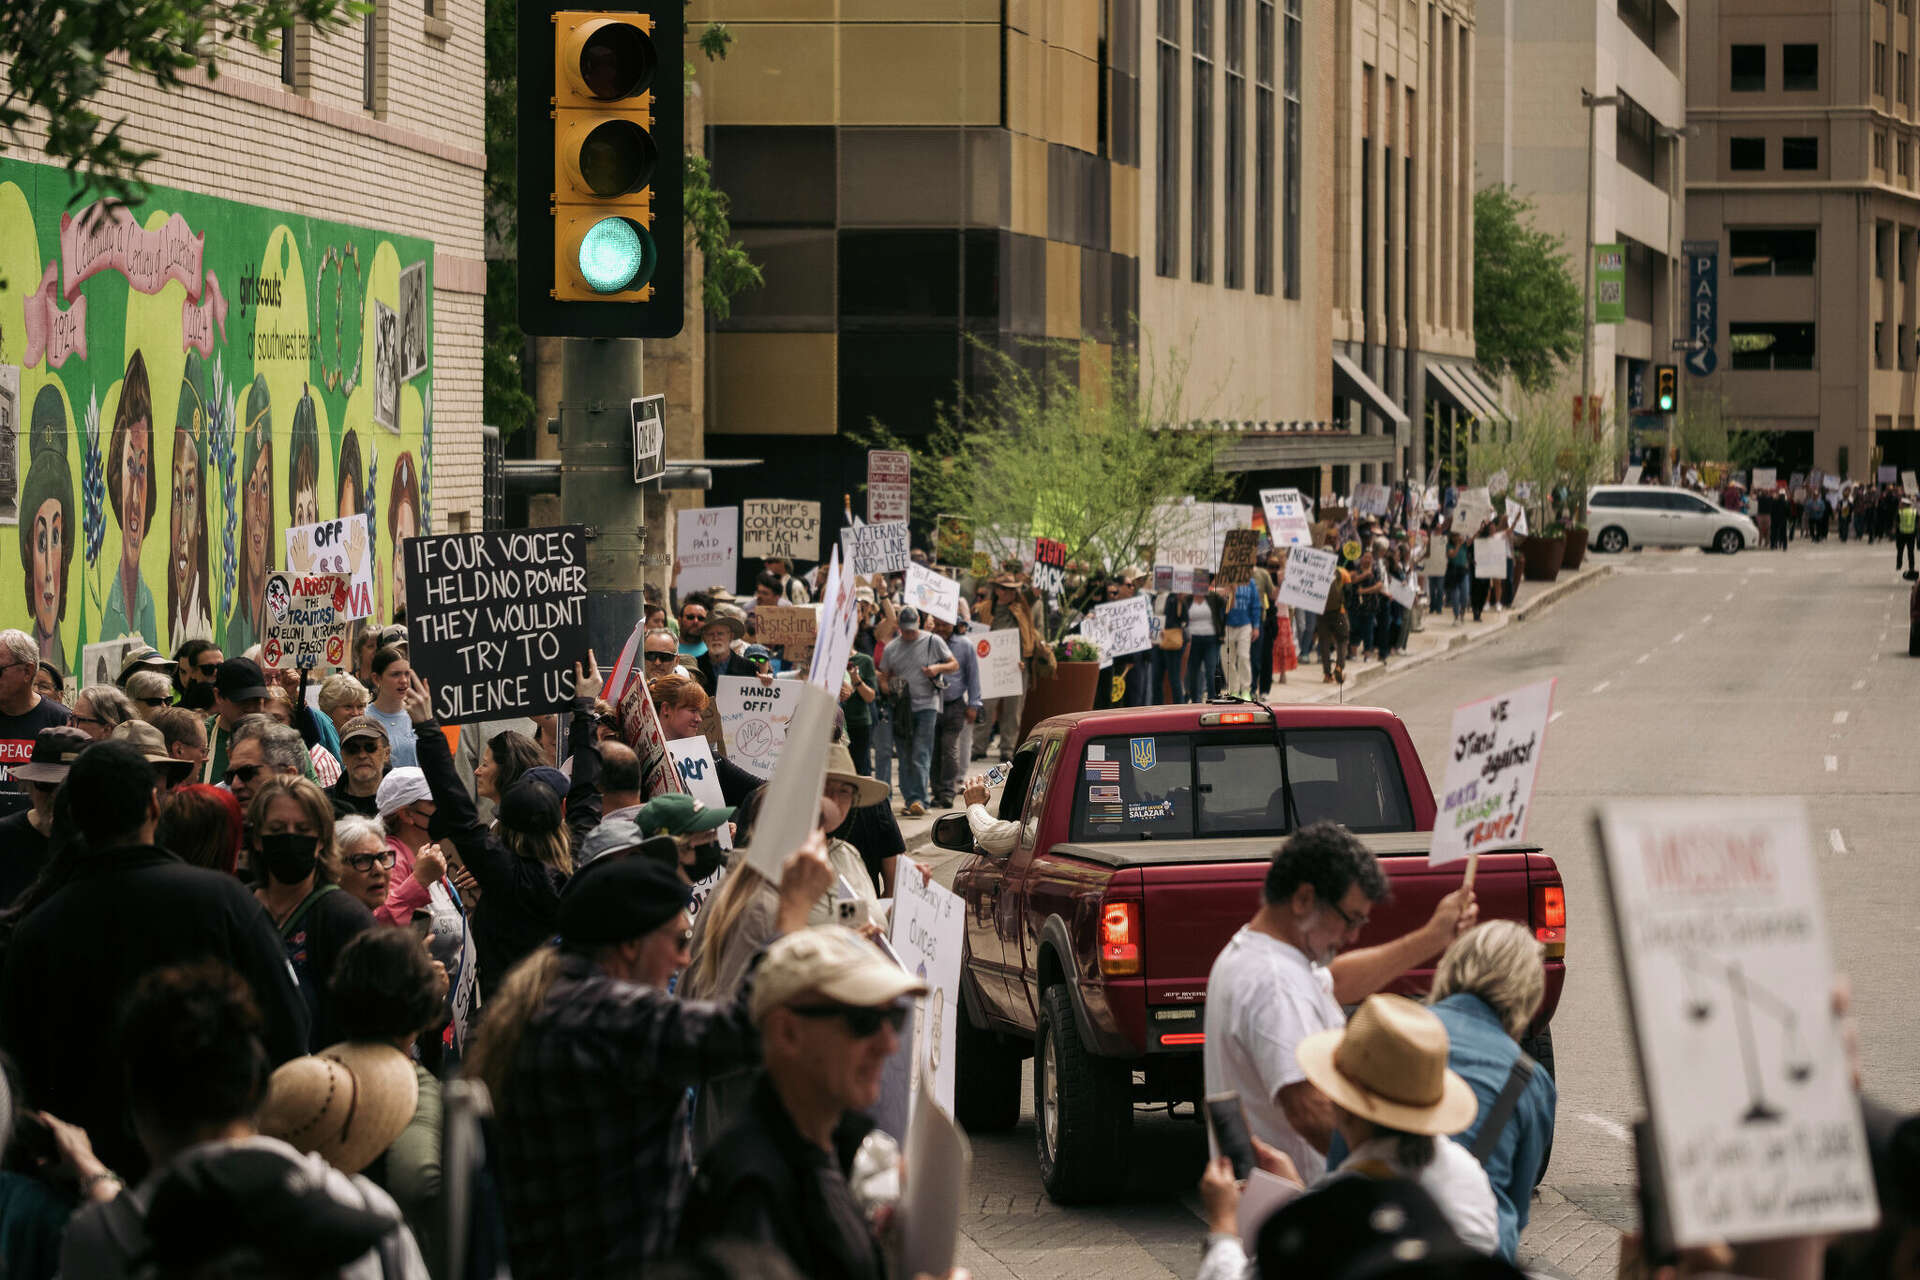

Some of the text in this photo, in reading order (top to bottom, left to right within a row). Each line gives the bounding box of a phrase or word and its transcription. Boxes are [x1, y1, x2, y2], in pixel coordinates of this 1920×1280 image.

[240, 263, 282, 319] girl scouts
[1696, 257, 1712, 343] PARK
[54, 313, 77, 359] 1924
[257, 319, 298, 361] southwest
[747, 503, 809, 517] TRUMP'S
[873, 501, 887, 511] 30
[696, 512, 720, 527] NOT
[314, 521, 342, 547] OFF
[744, 529, 799, 543] IMPEACH
[853, 522, 908, 541] VETERANS
[416, 532, 575, 574] IF OUR VOICES
[692, 538, 720, 550] PAID
[884, 538, 906, 555] LINE
[1035, 537, 1067, 567] FIGHT
[885, 552, 910, 572] LIFE
[291, 575, 335, 598] ARREST
[426, 565, 588, 606] HELD NO POWER
[1031, 560, 1067, 595] BACK
[305, 598, 320, 610] THE
[415, 594, 588, 644] THEY WOULDNT
[267, 626, 281, 640] NO
[283, 641, 295, 655] NO
[456, 630, 560, 675] TRY TO
[436, 668, 577, 719] SILENCE US
[740, 686, 781, 699] HANDS
[743, 700, 773, 713] OFF!
[1481, 730, 1536, 784] against
[1129, 808, 1165, 819] SALAZAR
